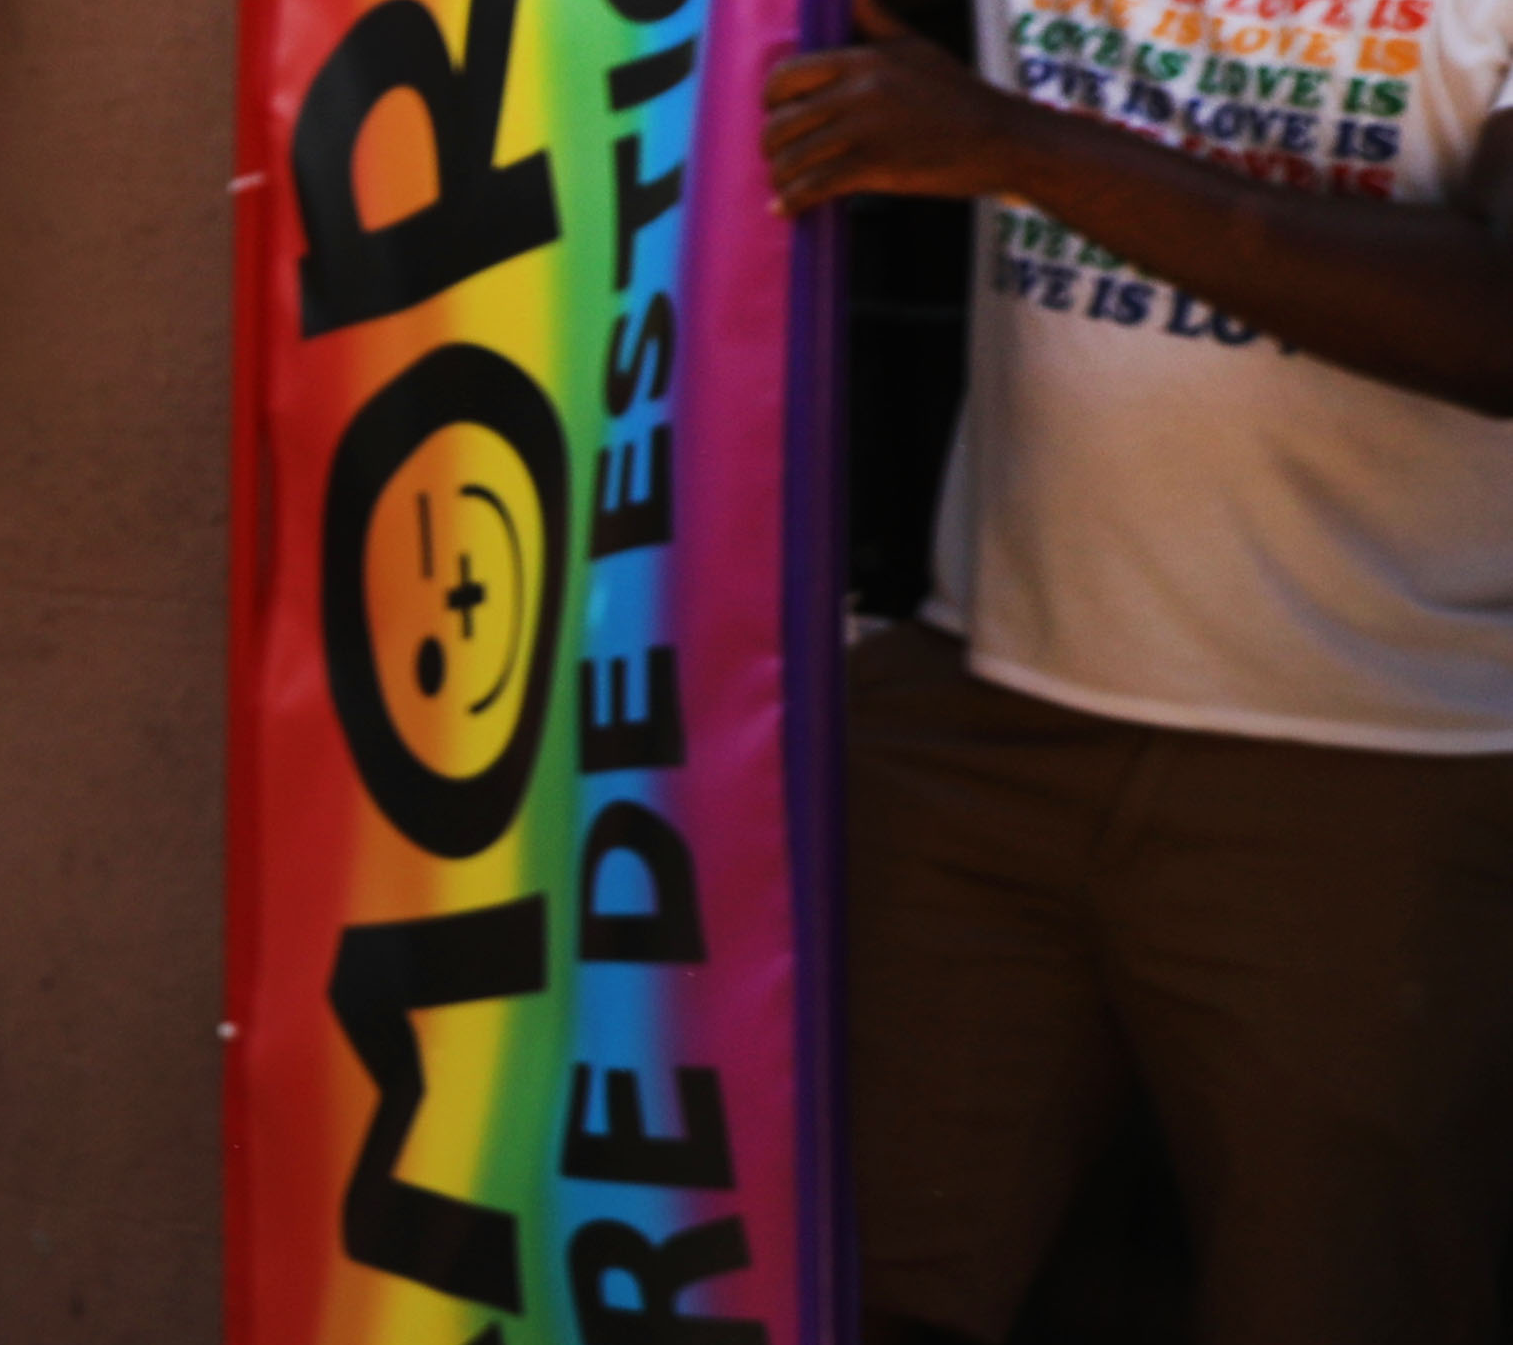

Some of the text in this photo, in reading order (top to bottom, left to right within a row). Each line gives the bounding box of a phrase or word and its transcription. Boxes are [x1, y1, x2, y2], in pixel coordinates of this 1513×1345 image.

[1152, 7, 1203, 47] IS
[1211, 16, 1340, 67] LOVE
[1356, 33, 1422, 76] IS
[1017, 55, 1112, 108] OVE
[1185, 99, 1319, 154] LOVE
[1332, 119, 1401, 162] IS
[1197, 55, 1332, 110] LOVE
[1342, 75, 1411, 118] IS
[1087, 274, 1156, 325] IS
[577, 645, 709, 965] DE
